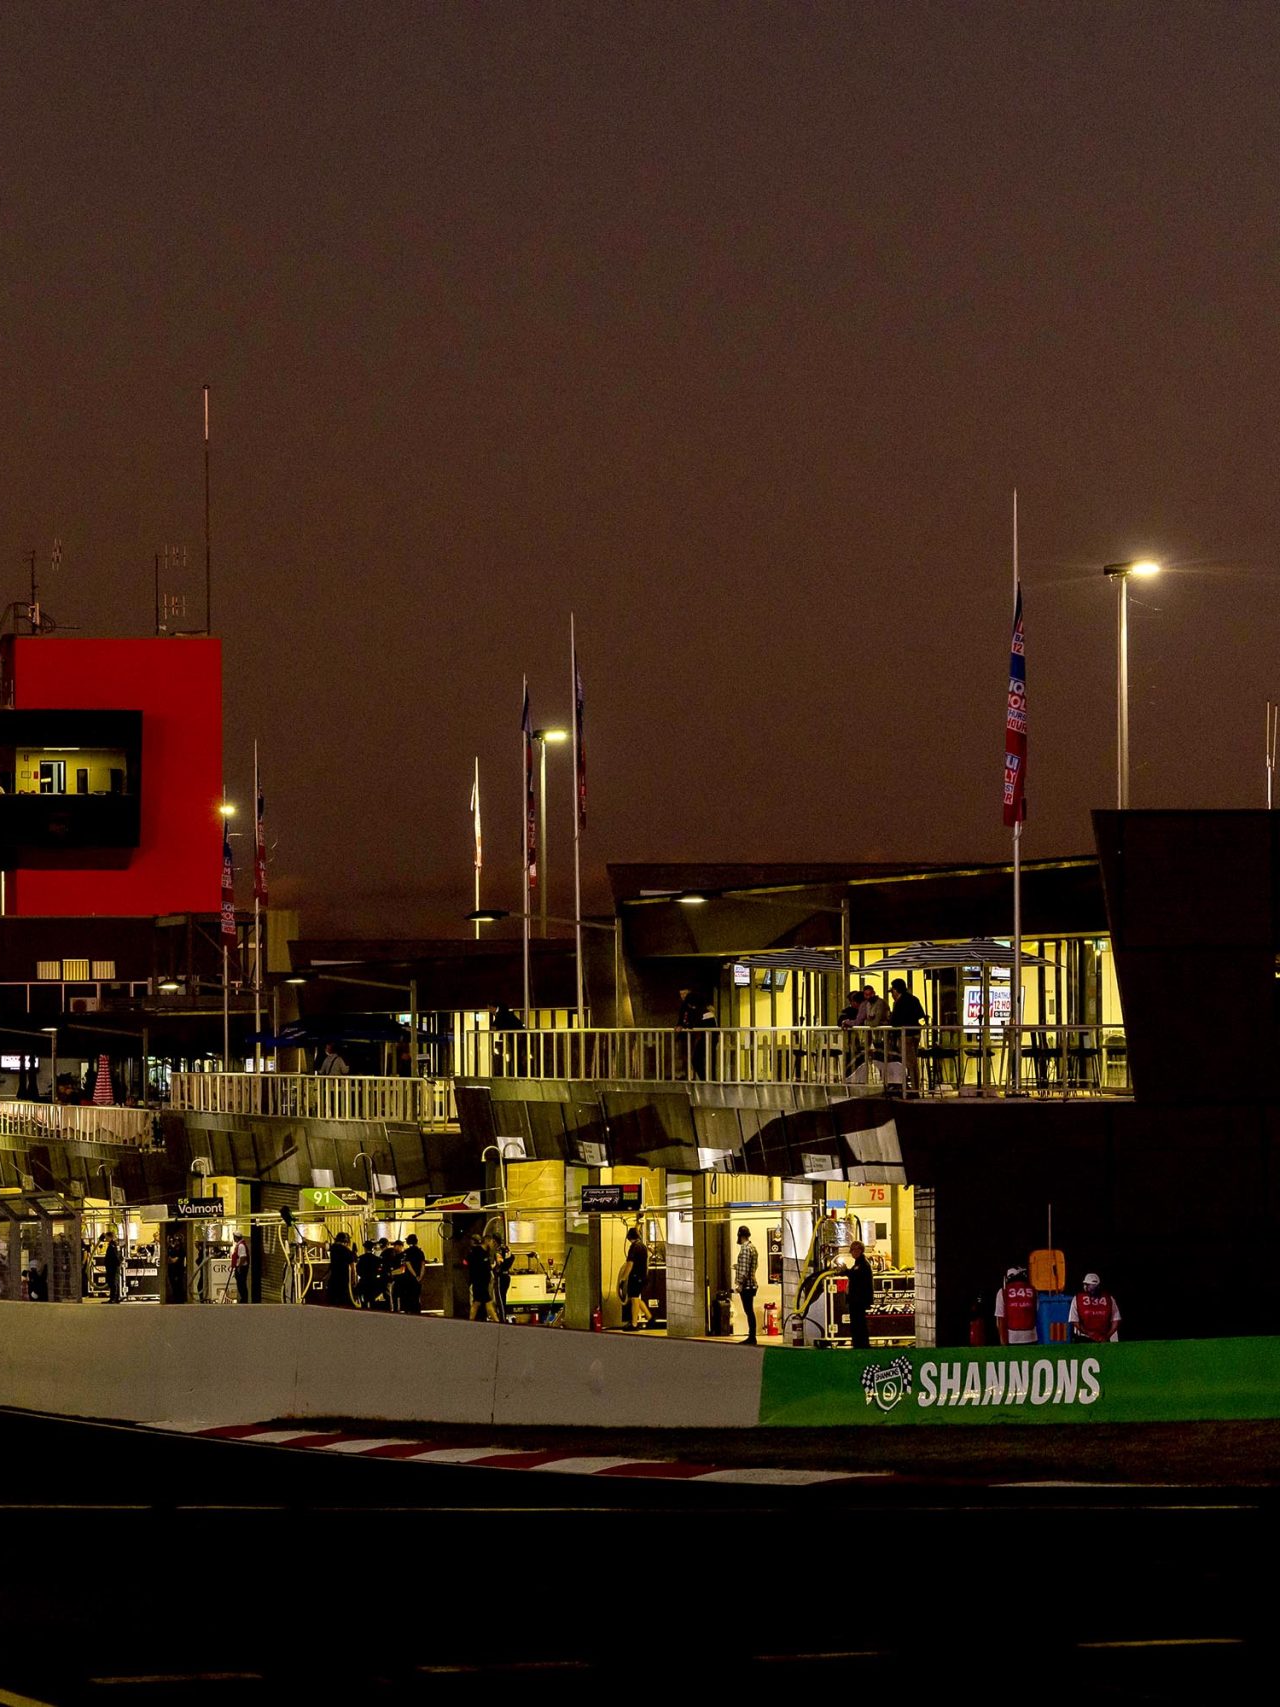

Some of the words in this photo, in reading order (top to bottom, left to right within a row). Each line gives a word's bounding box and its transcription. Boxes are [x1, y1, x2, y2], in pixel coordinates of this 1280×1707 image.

[313, 1191, 330, 1204] 91
[869, 1189, 885, 1200] 75
[178, 1203, 223, 1214] Valmont
[1008, 1288, 1033, 1298] 345
[1082, 1296, 1107, 1306] 334
[917, 1358, 1101, 1407] SHANNONS
